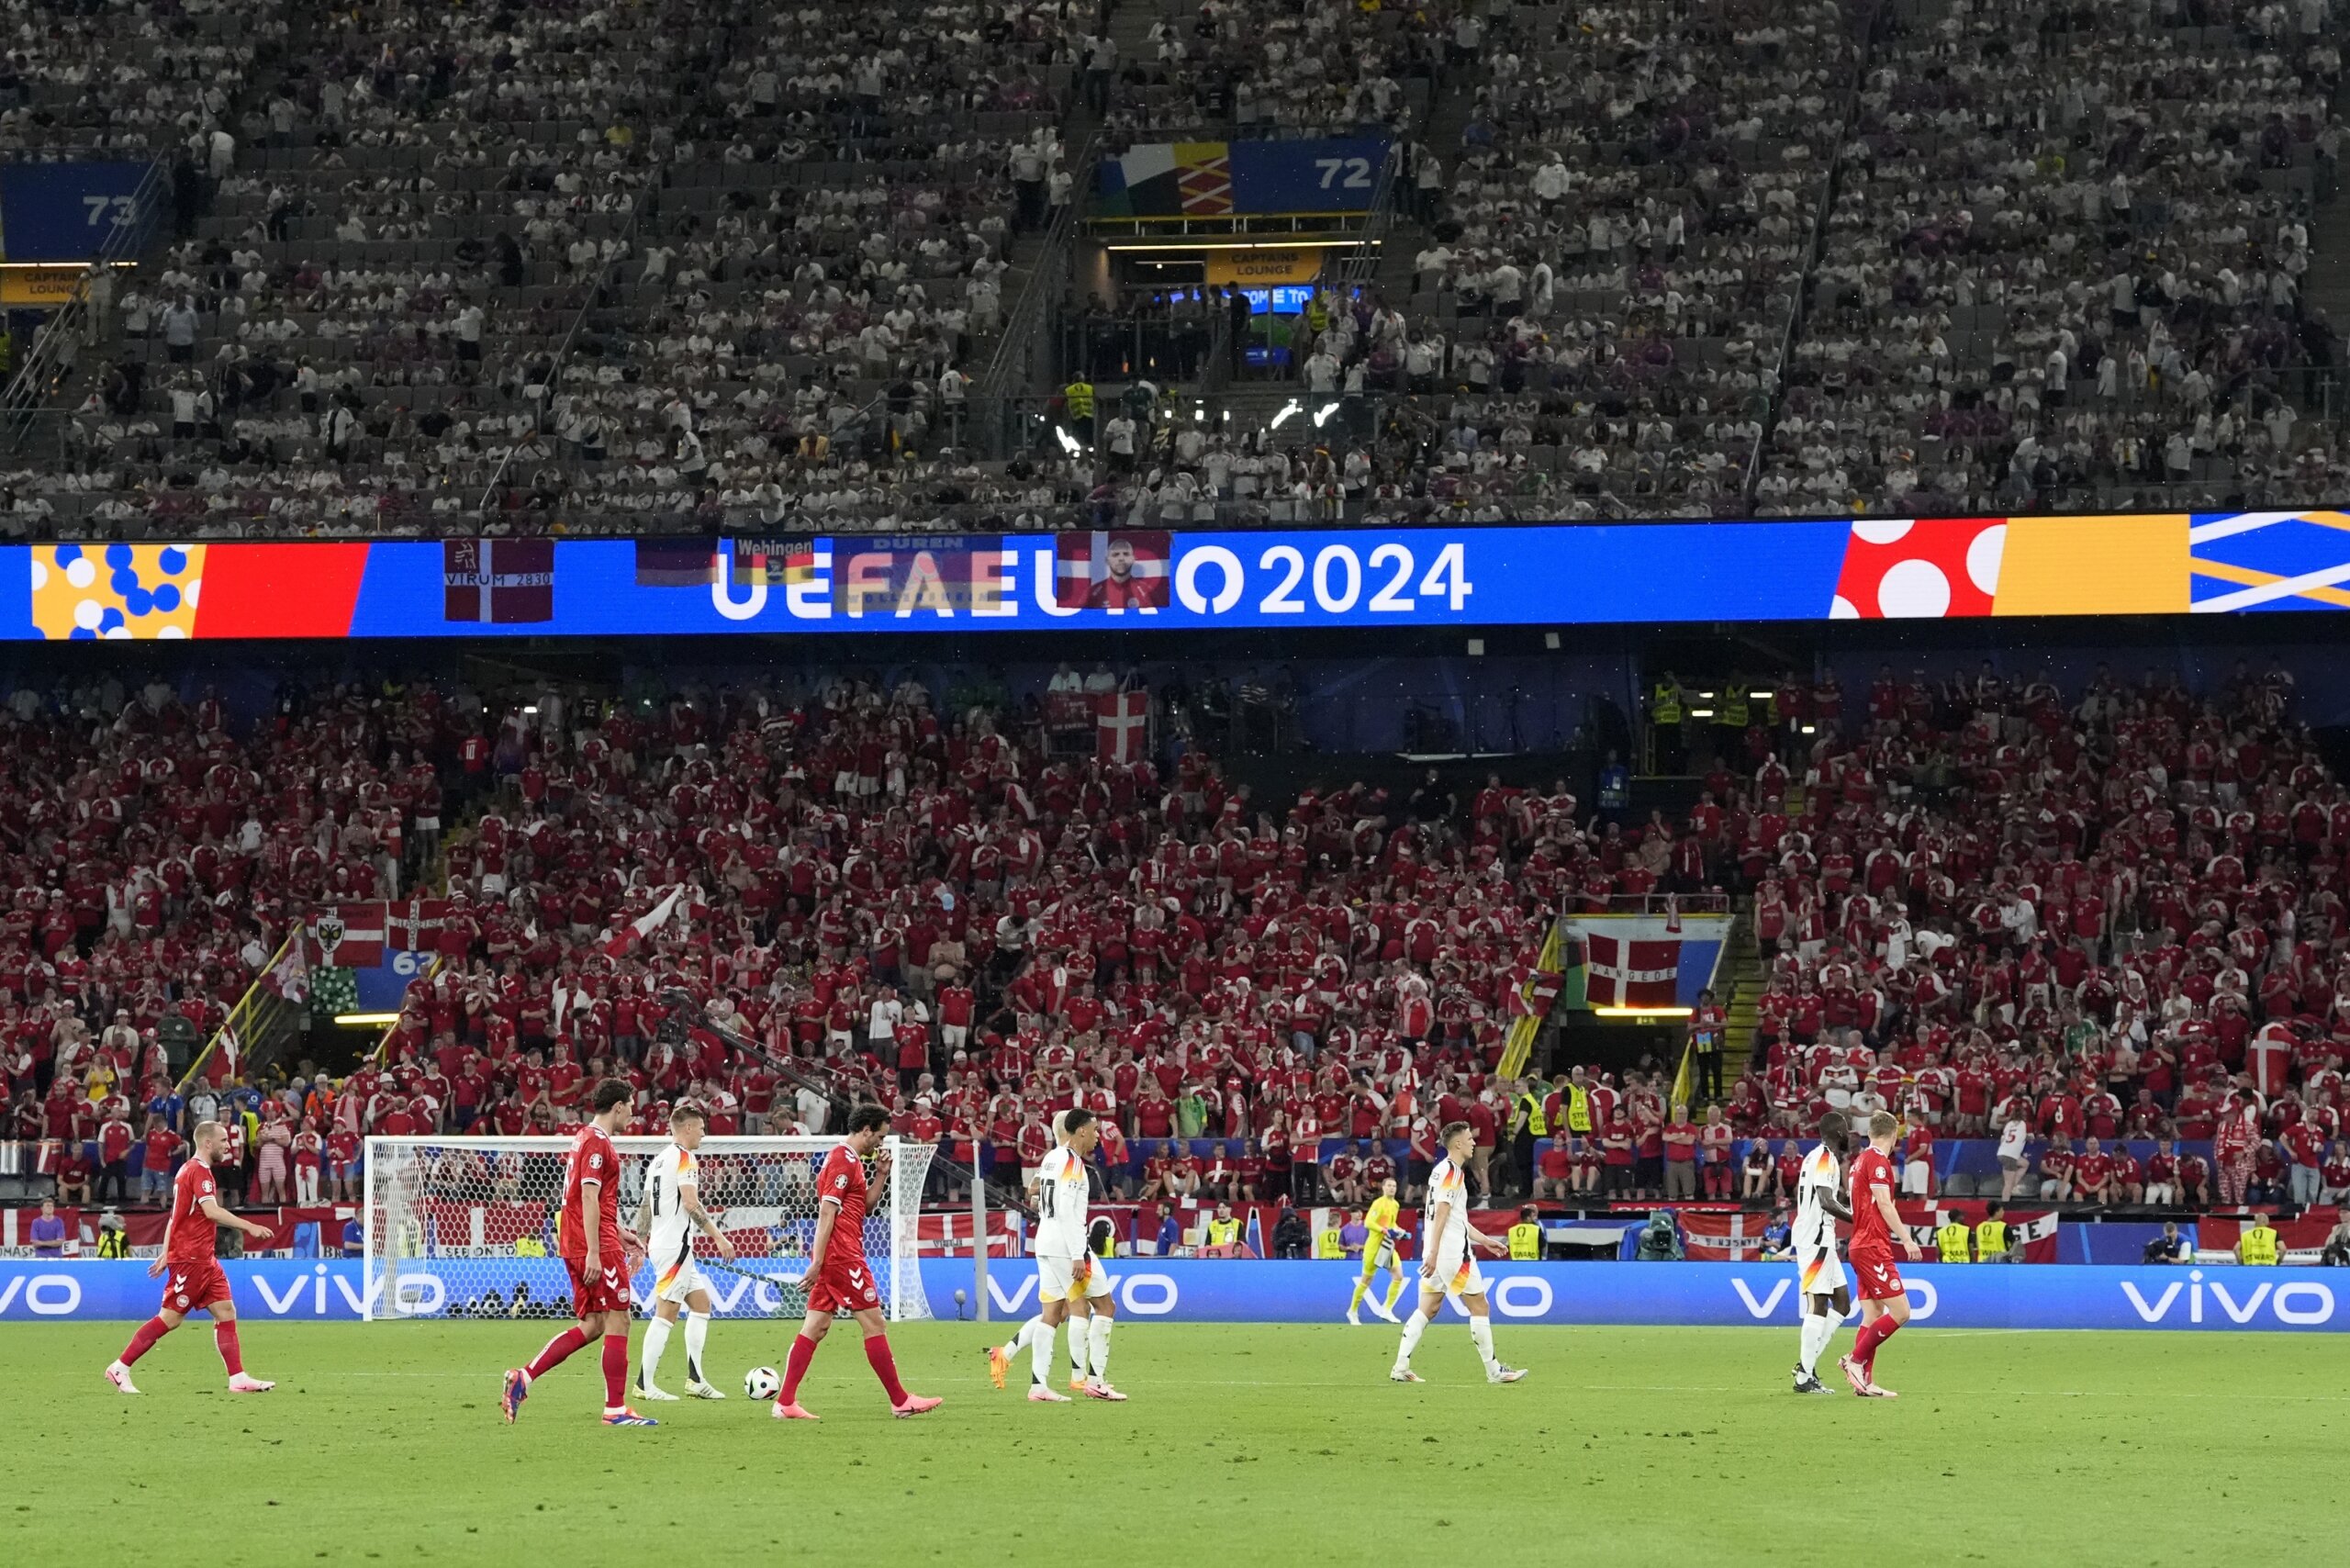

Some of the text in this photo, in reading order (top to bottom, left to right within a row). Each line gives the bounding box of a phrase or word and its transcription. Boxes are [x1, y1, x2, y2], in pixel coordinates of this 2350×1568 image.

[1315, 158, 1371, 188] 72
[83, 196, 137, 226] 73
[1231, 253, 1299, 263] CAPTAINS
[1237, 265, 1293, 274] LOUNGE
[24, 273, 83, 282] CAPTAIN
[29, 285, 79, 294] LOUNG
[738, 539, 812, 555] Wehingen
[446, 573, 551, 586] VIRUM 2830
[1259, 543, 1472, 614] 2024
[466, 745, 475, 759] 10
[1592, 965, 1673, 981] VANGEDE
[252, 1263, 445, 1314] vivo
[988, 1274, 1179, 1315] vo
[1352, 1276, 1553, 1316] vvo
[1731, 1278, 1938, 1320] vo
[2121, 1270, 2334, 1324] vivo
